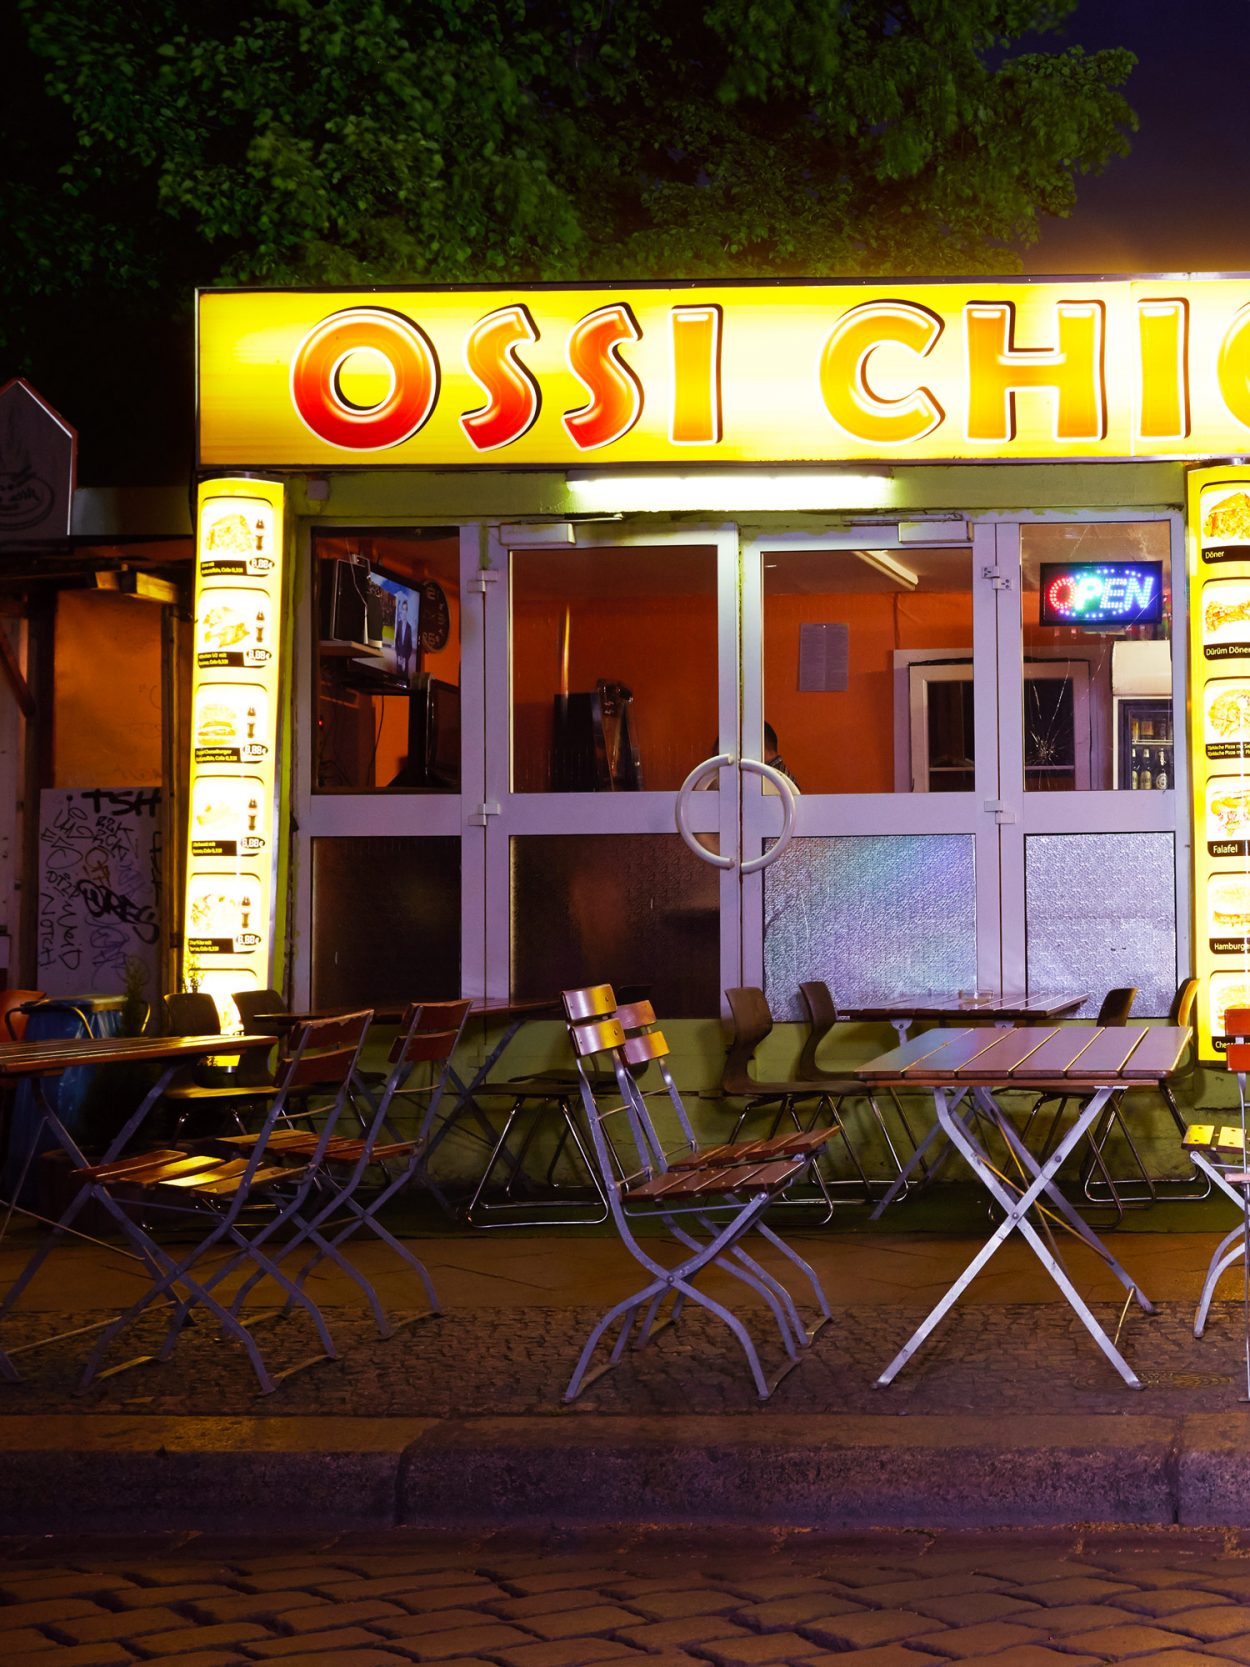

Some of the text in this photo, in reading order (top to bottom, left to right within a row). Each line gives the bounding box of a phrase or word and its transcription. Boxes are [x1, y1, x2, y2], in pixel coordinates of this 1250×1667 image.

[289, 302, 723, 452] OSSI
[1205, 551, 1225, 559] Döner
[1049, 575, 1155, 611] OPEN
[1206, 646, 1250, 656] Dürüm Döner
[1213, 844, 1238, 854] Falafel
